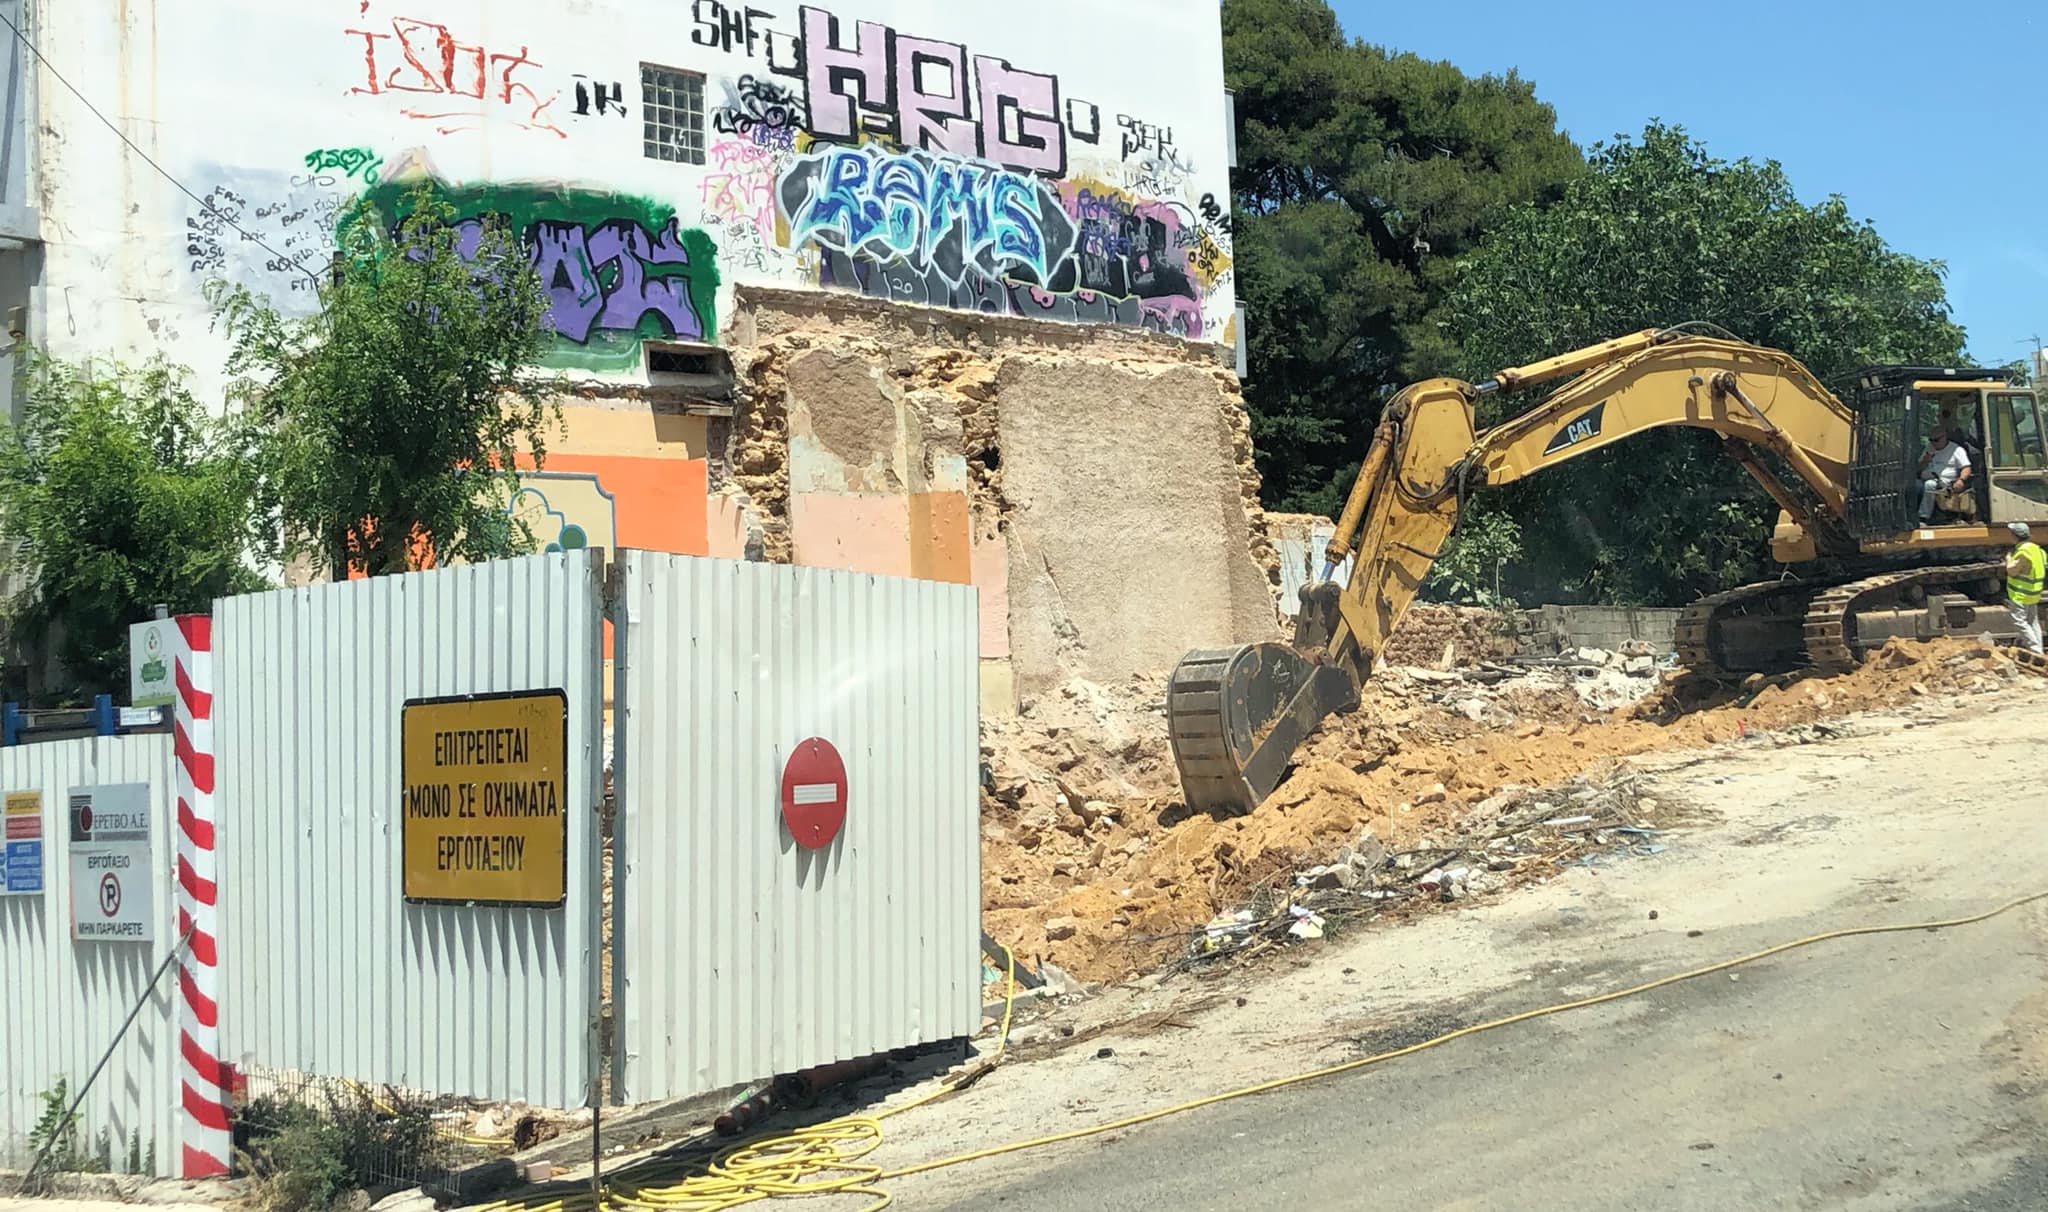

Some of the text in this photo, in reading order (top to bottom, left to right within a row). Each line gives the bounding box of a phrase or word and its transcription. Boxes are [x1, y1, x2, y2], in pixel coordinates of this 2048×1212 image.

[1567, 418, 1593, 443] CAT
[435, 727, 529, 766] ΕΠΙΤΡΕΠΕΤΑΙ
[410, 781, 558, 818] ΜΟΝΟ ΣΕ ΟΧΗΜΑΤΑ
[87, 855, 131, 869] ΕΡΓΟΤΑΞΙΟ
[438, 835, 525, 871] ΕΡΓΟΤΑΞΙΟΥ
[96, 921, 144, 936] ΠΑΡΚΑΡΕΤΕ
